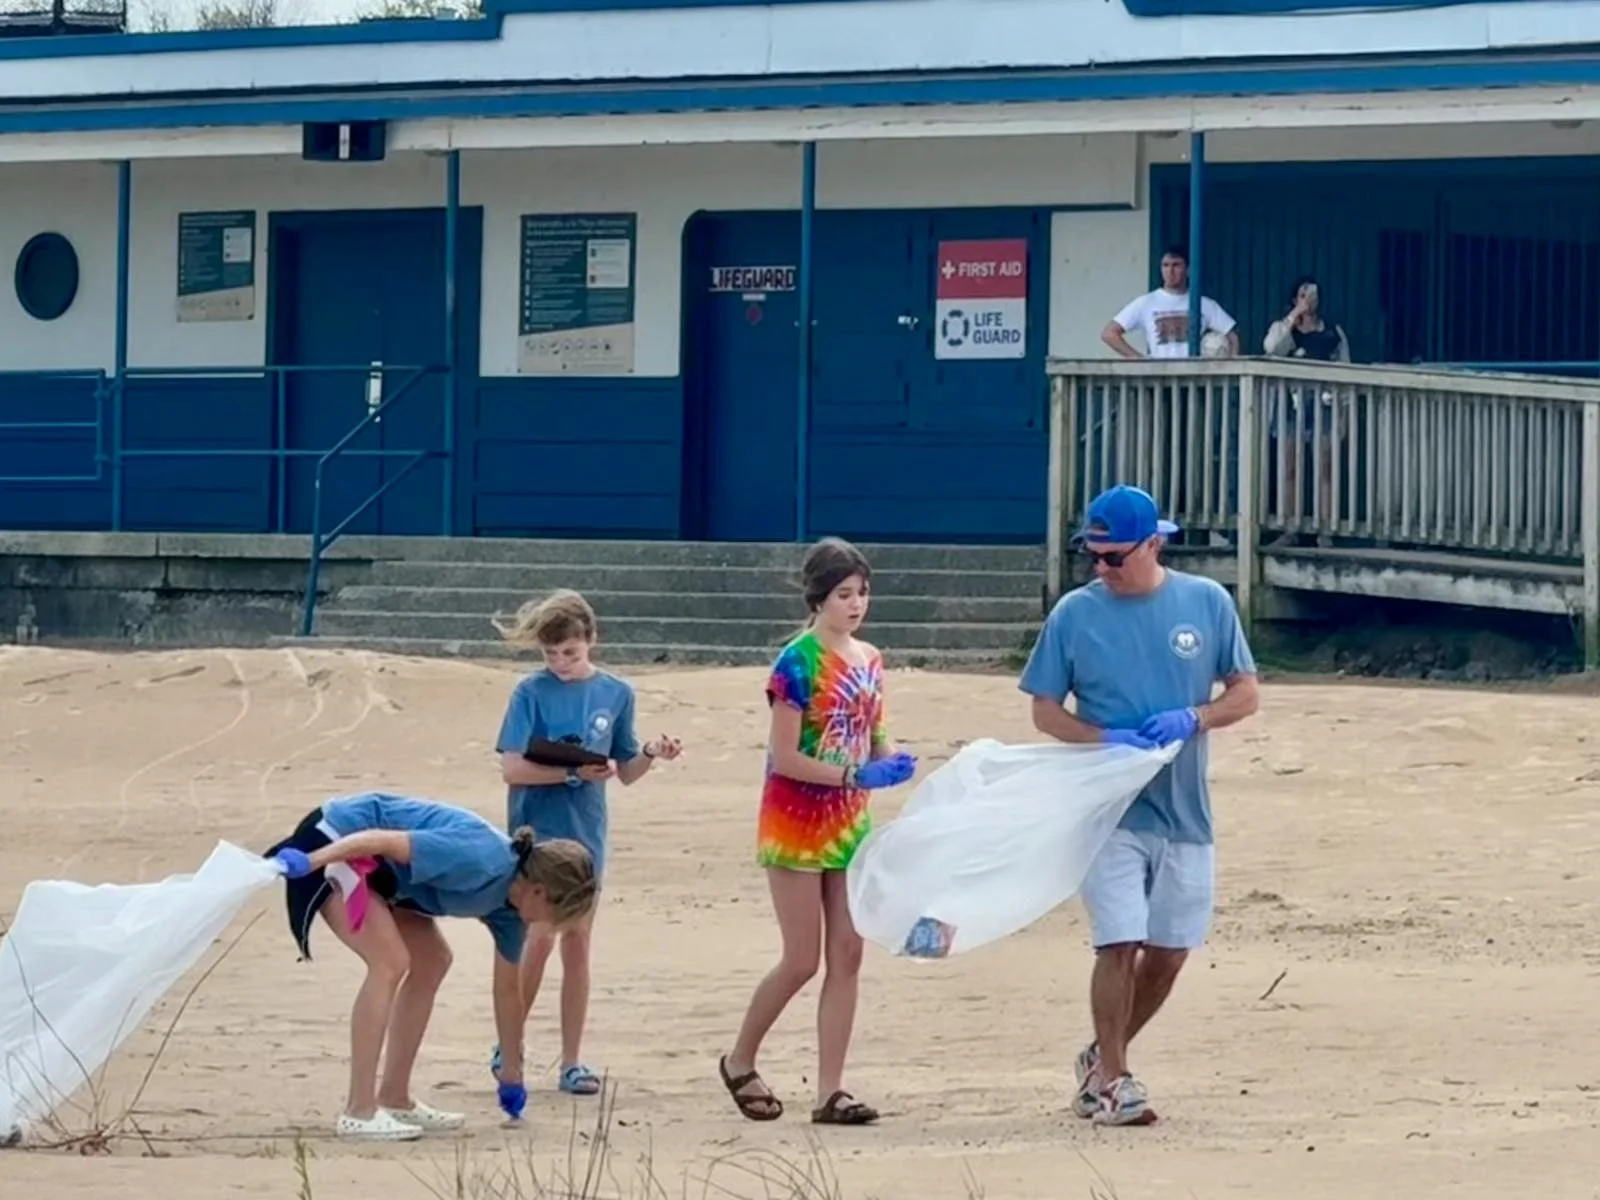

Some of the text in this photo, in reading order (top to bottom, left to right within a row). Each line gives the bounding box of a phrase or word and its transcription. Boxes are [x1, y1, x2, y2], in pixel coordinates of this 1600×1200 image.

[958, 261, 1022, 277] FIRST AID
[974, 312, 1003, 327] LIFE
[972, 328, 1021, 344] GUARD
